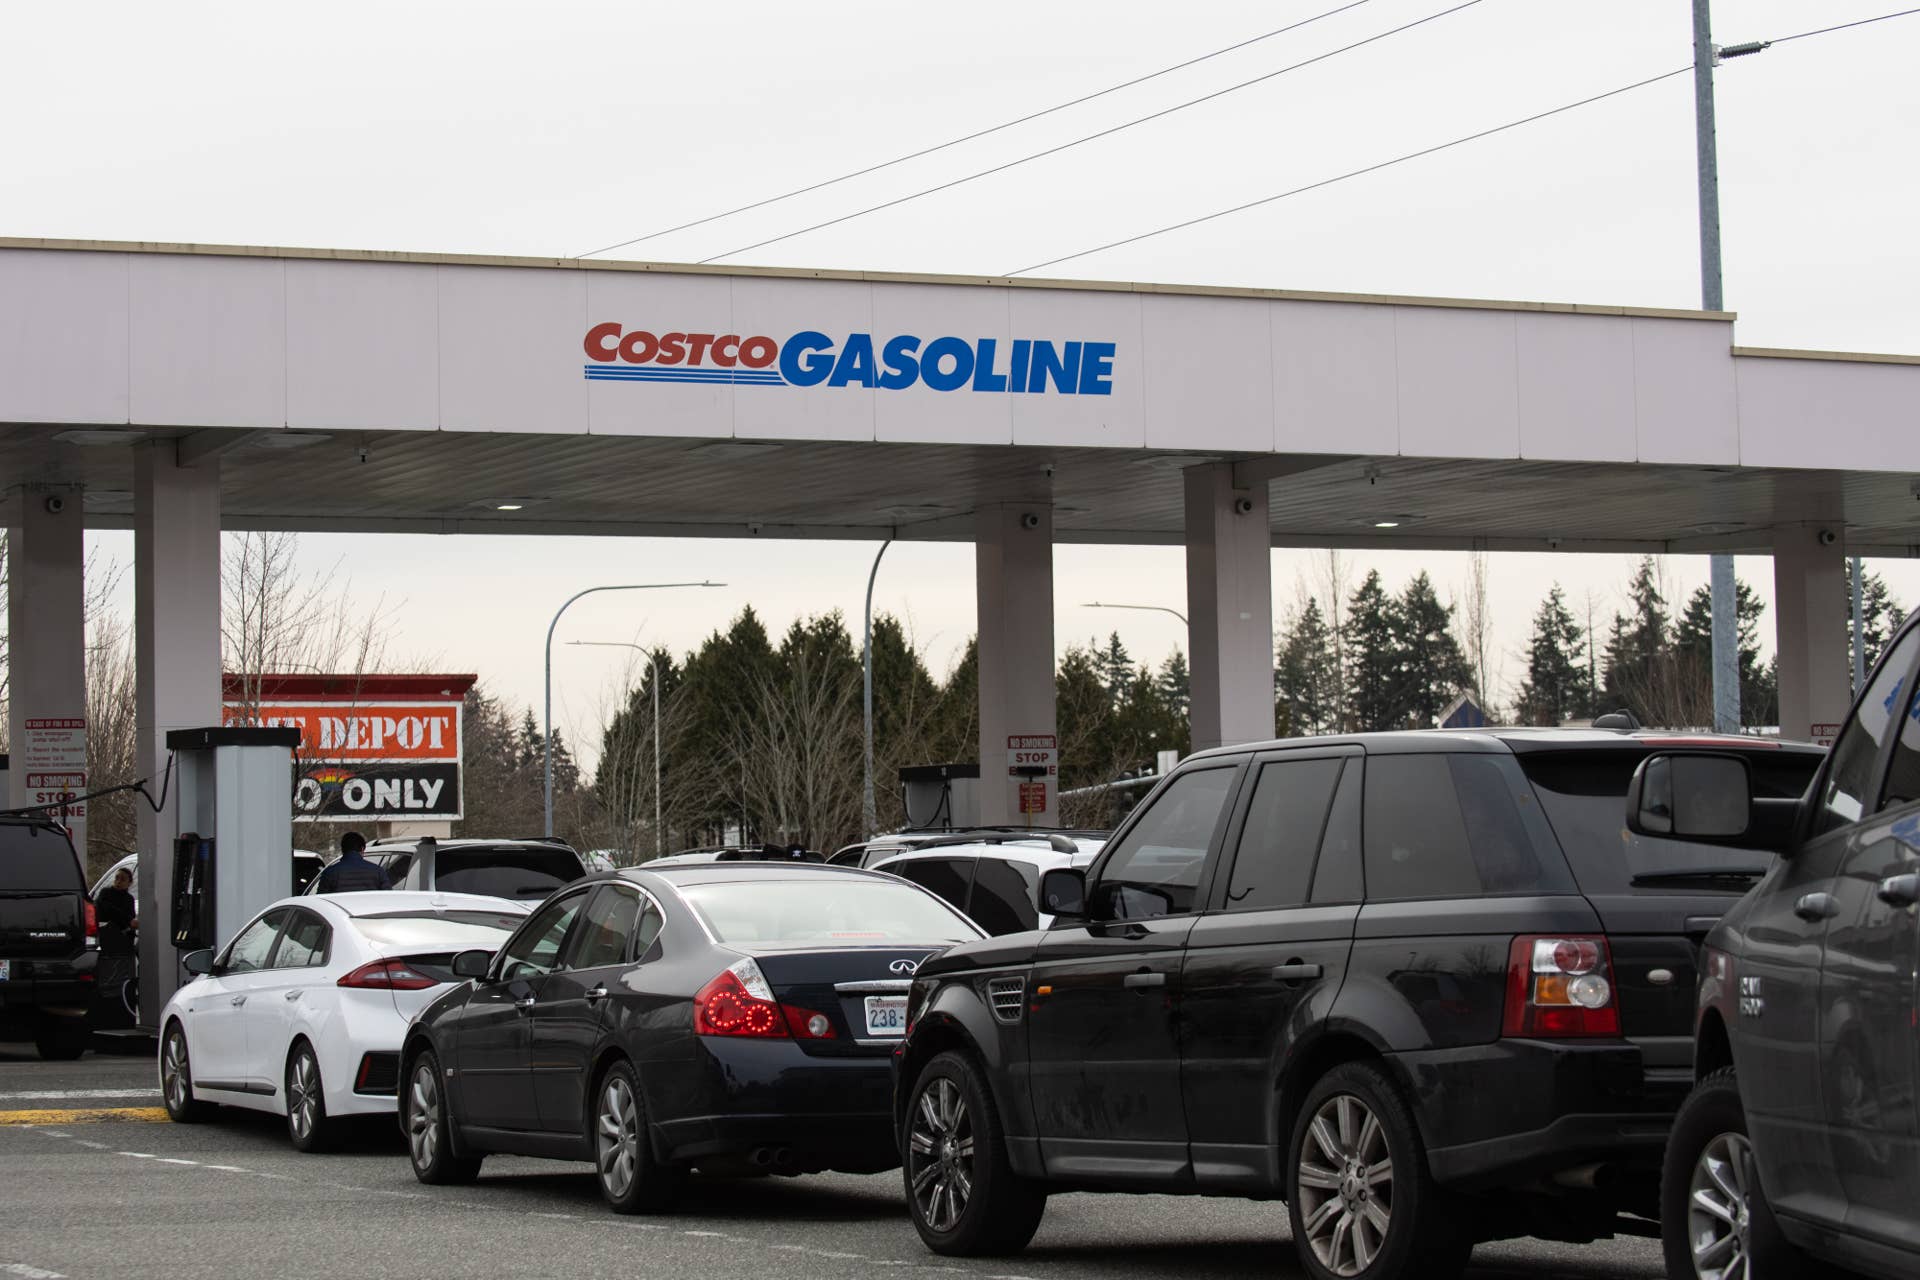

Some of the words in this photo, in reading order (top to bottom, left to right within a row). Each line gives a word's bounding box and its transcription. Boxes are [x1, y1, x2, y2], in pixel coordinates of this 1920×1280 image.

[584, 322, 778, 368] COSTCO
[779, 331, 1117, 395] GASOLINE
[319, 716, 449, 750] DEPOT
[1016, 753, 1049, 762] STOP
[29, 775, 41, 787] NO
[43, 775, 82, 787] SMOKING
[36, 792, 77, 803] STOP
[343, 778, 445, 810] ONLY
